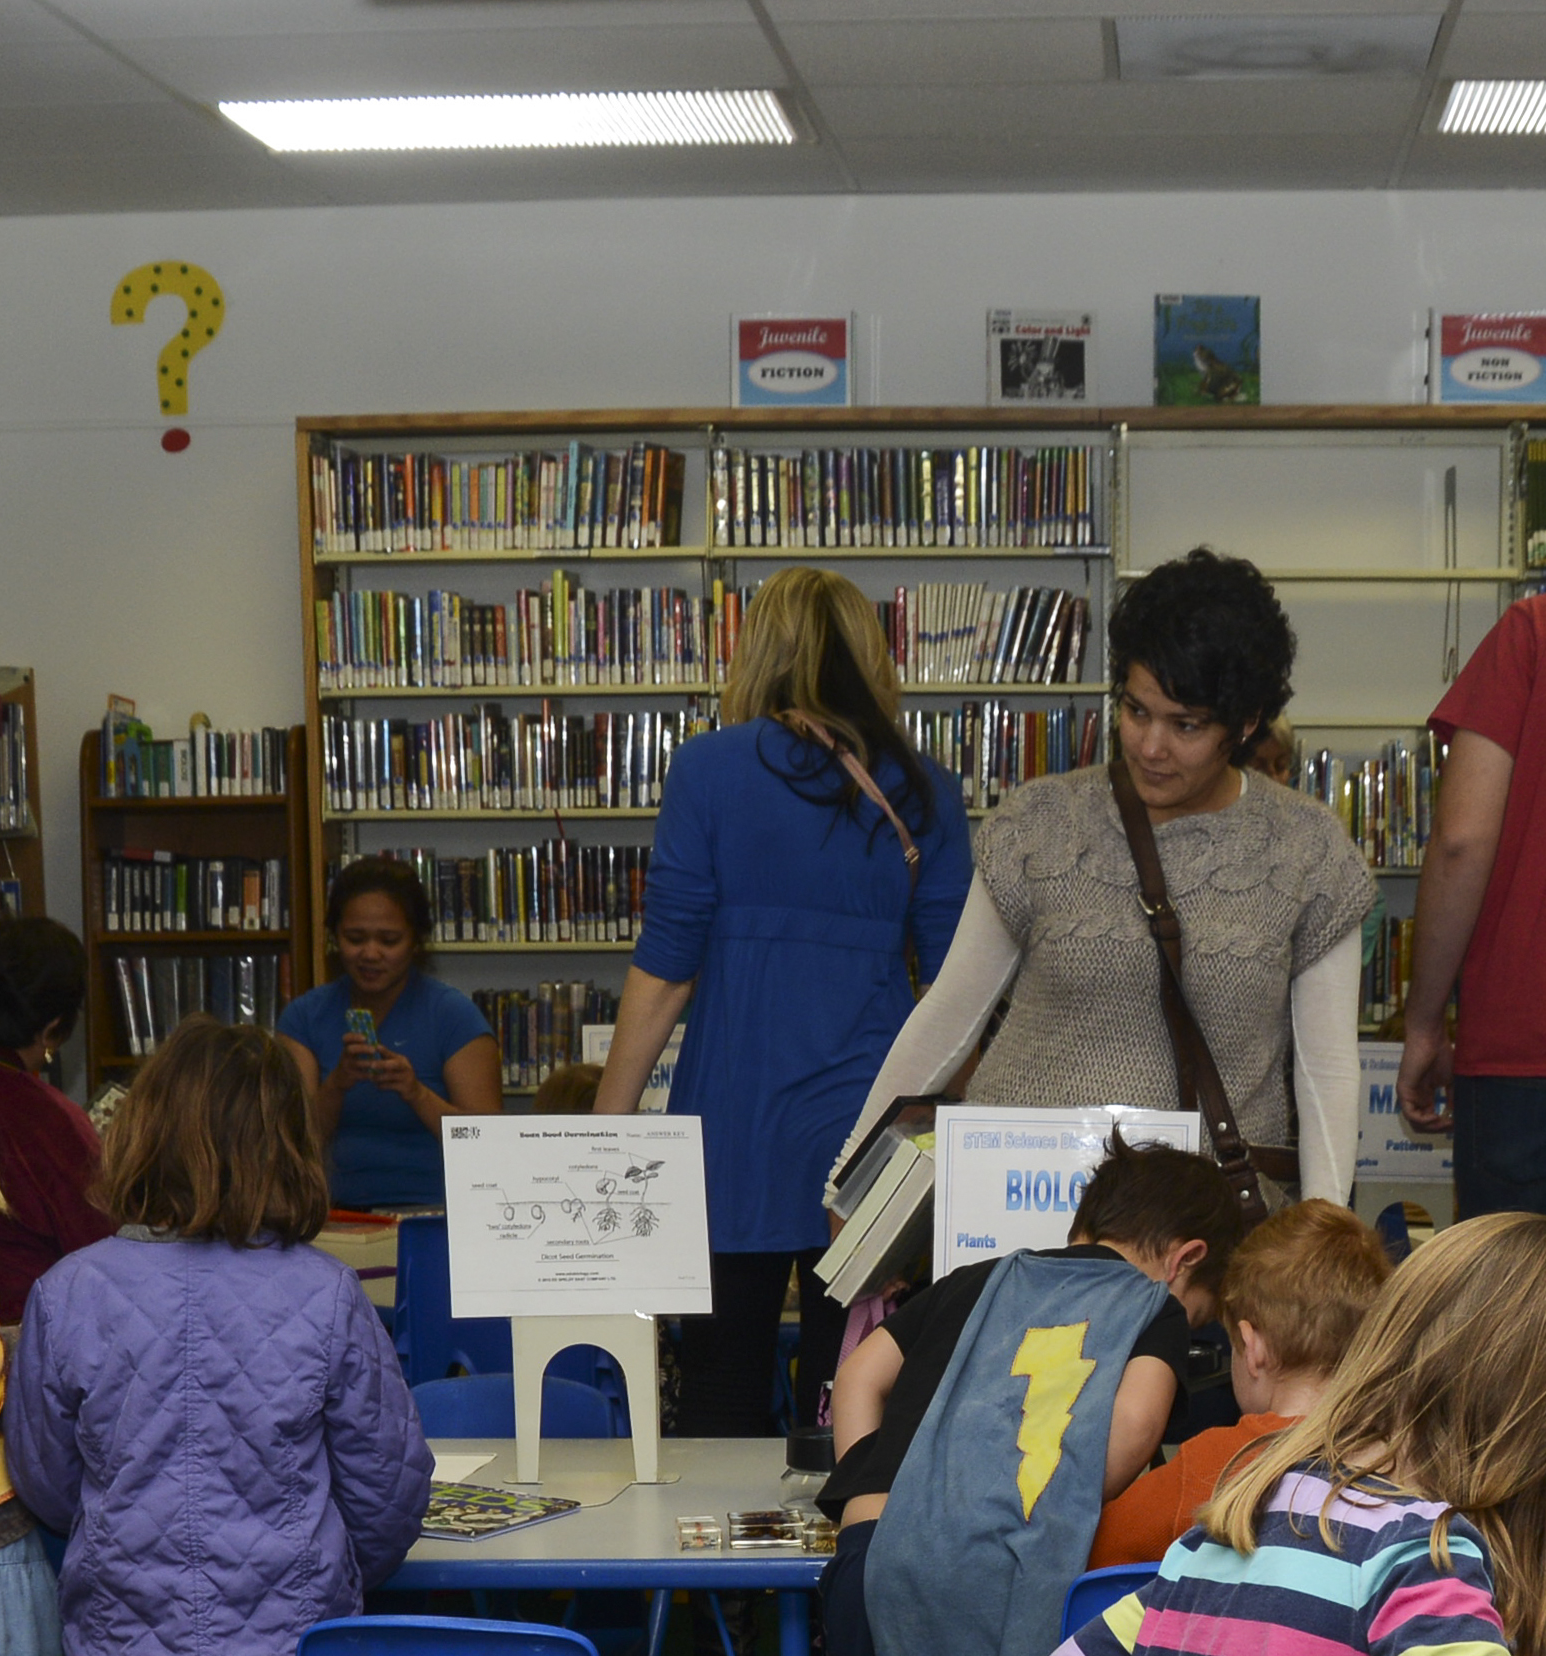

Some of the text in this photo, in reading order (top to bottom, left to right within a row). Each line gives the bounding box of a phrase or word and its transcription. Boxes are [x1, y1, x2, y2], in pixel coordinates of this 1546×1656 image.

[757, 325, 828, 350] Juvenile
[1015, 325, 1091, 337] Color and Light
[1460, 321, 1533, 346] Juvenile
[1480, 357, 1510, 367] NON
[760, 366, 825, 379] FICTION
[1467, 370, 1523, 381] FICTION
[963, 1132, 1001, 1149] STEM
[1005, 1132, 1058, 1150] Science
[956, 1233, 997, 1249] Plants
